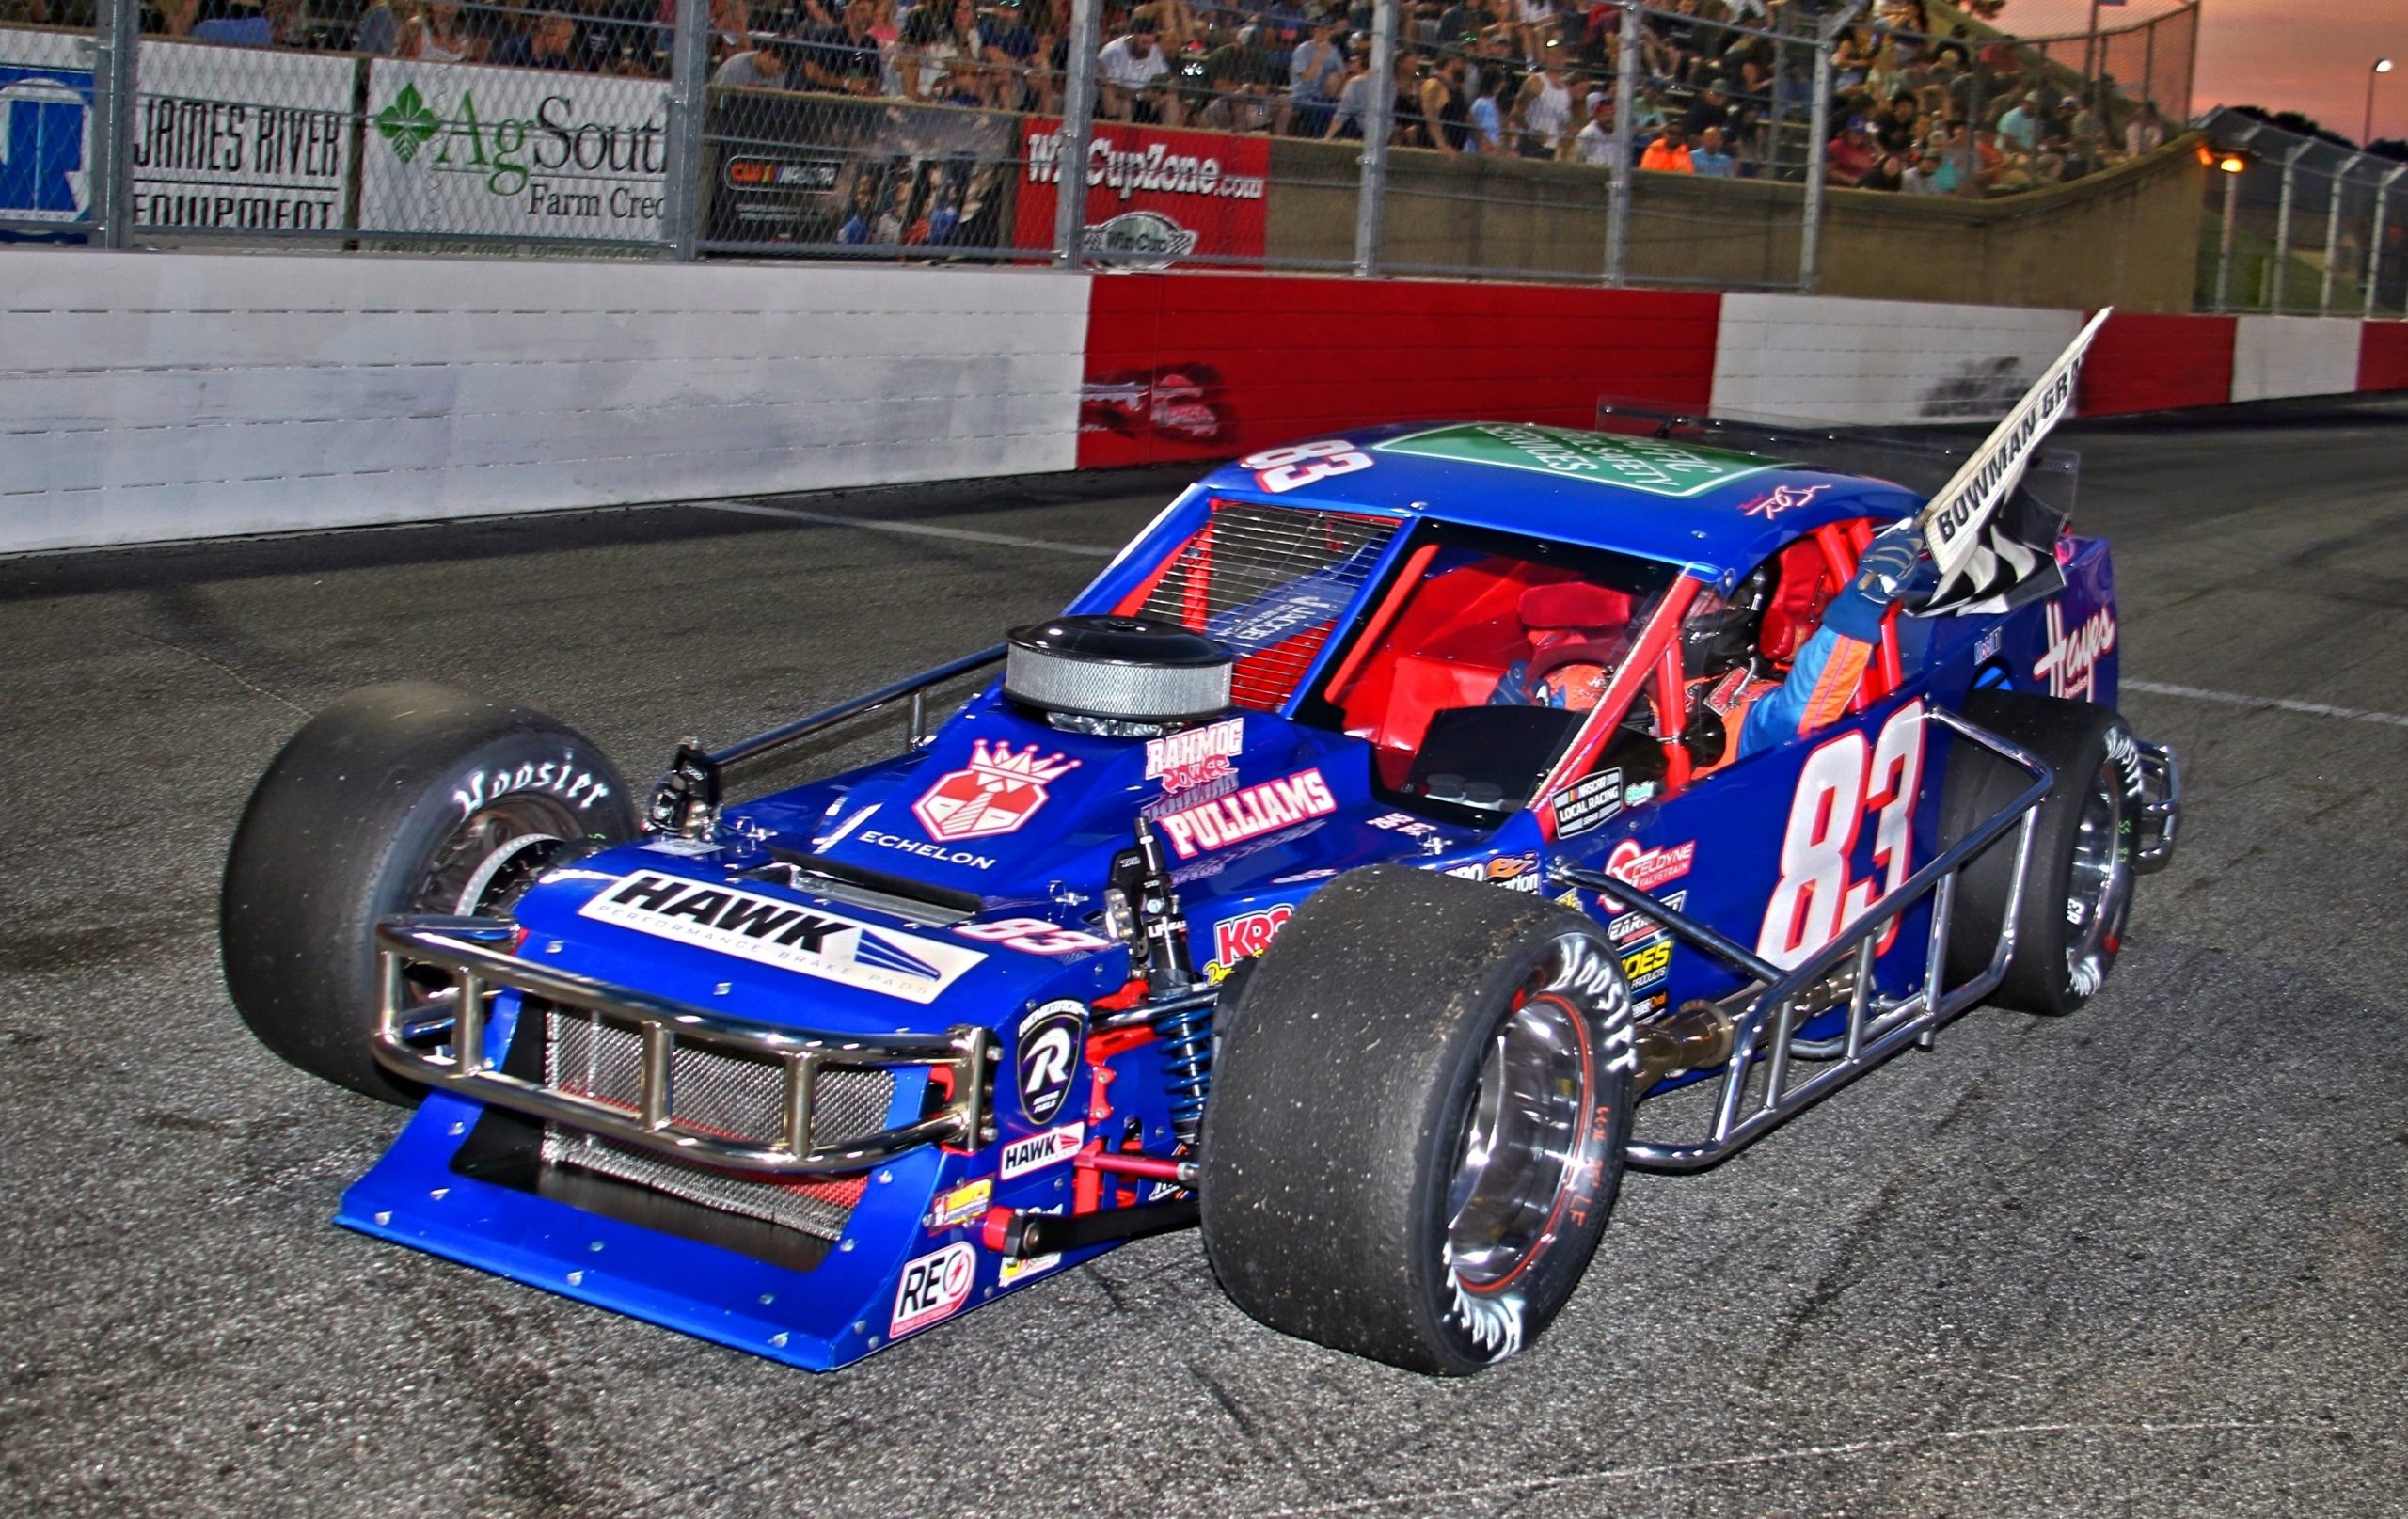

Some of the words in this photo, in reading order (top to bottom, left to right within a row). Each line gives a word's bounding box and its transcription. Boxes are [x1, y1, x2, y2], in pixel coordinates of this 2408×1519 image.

[134, 99, 245, 172] JAMES
[254, 108, 340, 177] RIVER
[1028, 134, 1265, 199] WiCupZone.com
[527, 183, 600, 216] Farm
[1238, 439, 1375, 495] 83
[1476, 425, 1599, 472] SERVICES
[1583, 445, 1681, 487] SAFETY
[1936, 403, 2036, 545] BOWMAN
[1159, 767, 1337, 860] PULLIAMS
[1559, 799, 1588, 823] LOCAL
[1588, 785, 1618, 809] RACING
[857, 830, 997, 870] ECHELON
[1756, 695, 1926, 973] 83
[610, 875, 853, 955] HAWK
[952, 916, 1111, 956] 83
[597, 904, 762, 953] PERFORMANCE
[777, 950, 852, 976] BRAKE
[867, 973, 930, 995] PADS
[1622, 941, 1671, 980] OES
[1630, 966, 1667, 989] PRODUCTS
[1022, 1027, 1069, 1094] R
[1004, 1133, 1058, 1170] HAWK
